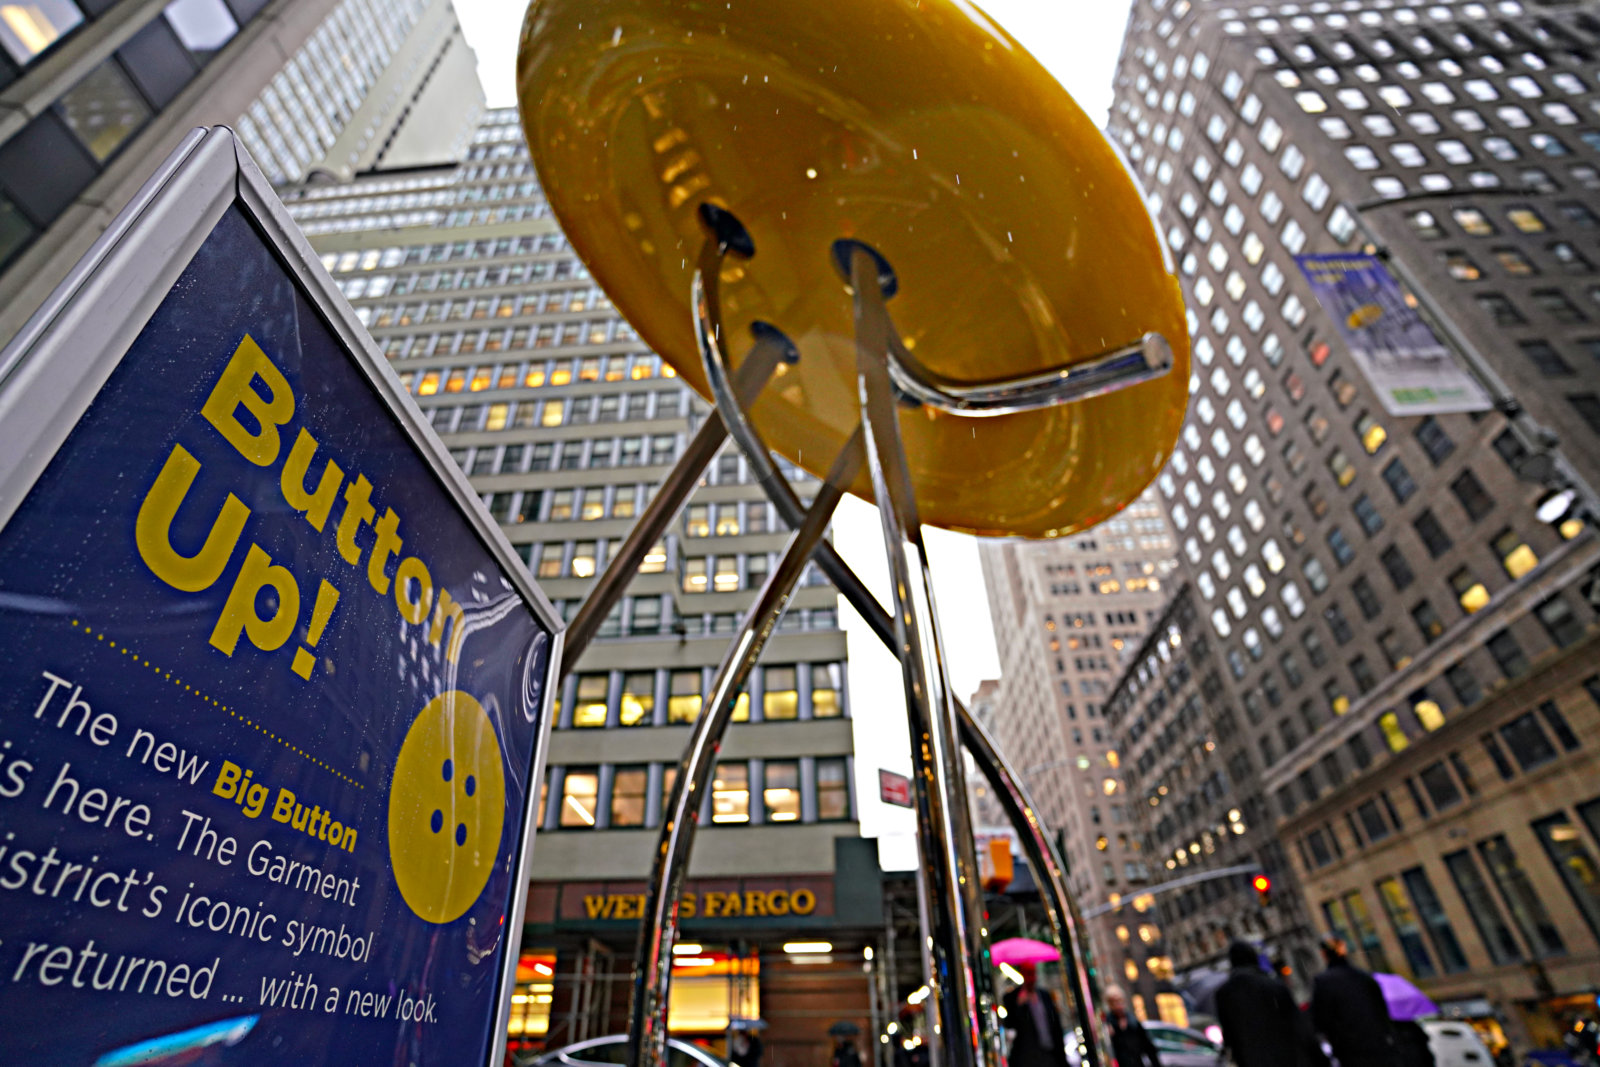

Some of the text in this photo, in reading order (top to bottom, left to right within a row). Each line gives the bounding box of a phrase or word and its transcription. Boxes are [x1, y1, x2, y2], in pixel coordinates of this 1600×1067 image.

[136, 442, 341, 682] Up!
[200, 333, 465, 666] Button
[34, 671, 358, 853] The new Big Button
[43, 762, 154, 842] here.
[177, 809, 237, 866] The
[247, 840, 361, 907] Garment
[175, 882, 277, 942] iconic
[282, 919, 374, 963] symbol
[584, 888, 817, 919] WES FARGO
[13, 940, 221, 1000] returned
[258, 970, 319, 1011] with
[324, 986, 341, 1013] a
[345, 989, 393, 1019] new
[395, 988, 438, 1024] look.
